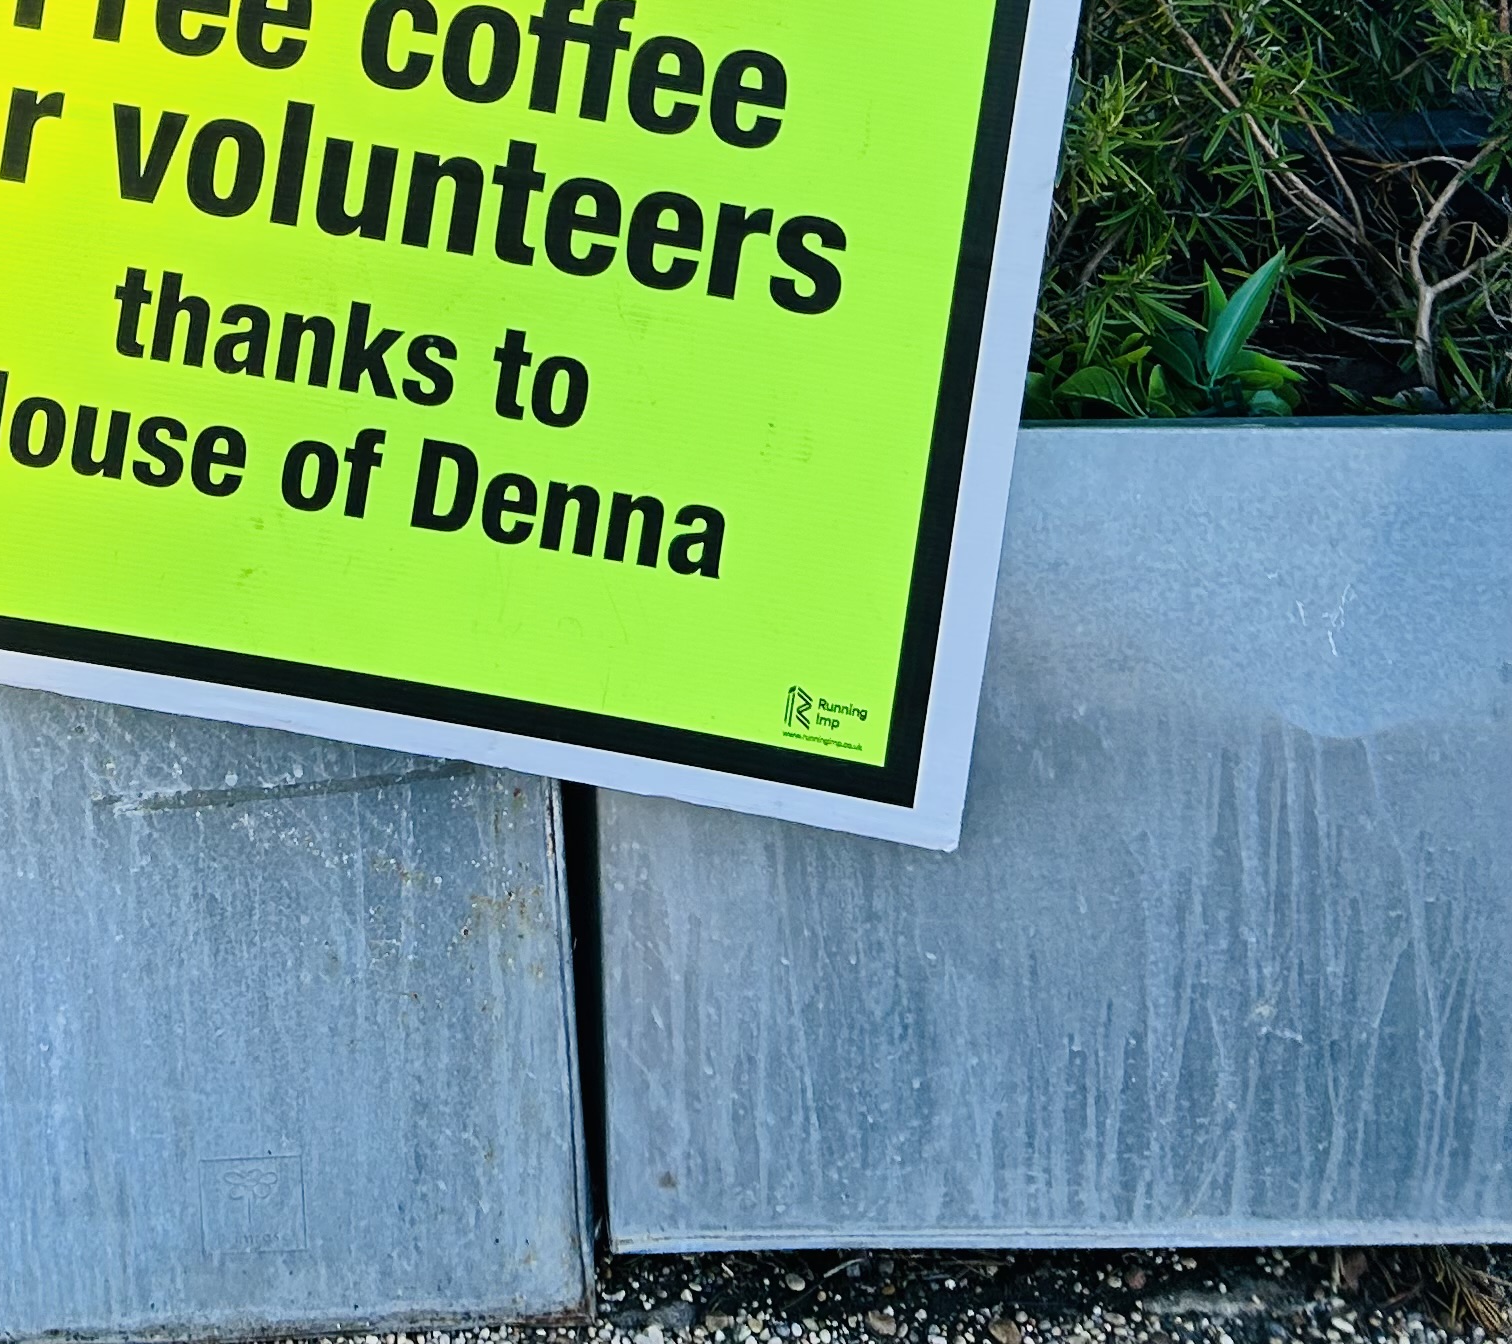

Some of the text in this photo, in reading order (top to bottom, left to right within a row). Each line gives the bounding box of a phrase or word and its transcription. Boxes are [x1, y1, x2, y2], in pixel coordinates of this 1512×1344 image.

[113, 100, 847, 315] volunteers
[114, 267, 589, 428] thanks to
[282, 428, 387, 519] of
[410, 437, 726, 580] Denna
[816, 712, 840, 730] Imp
[818, 698, 867, 721] Running
